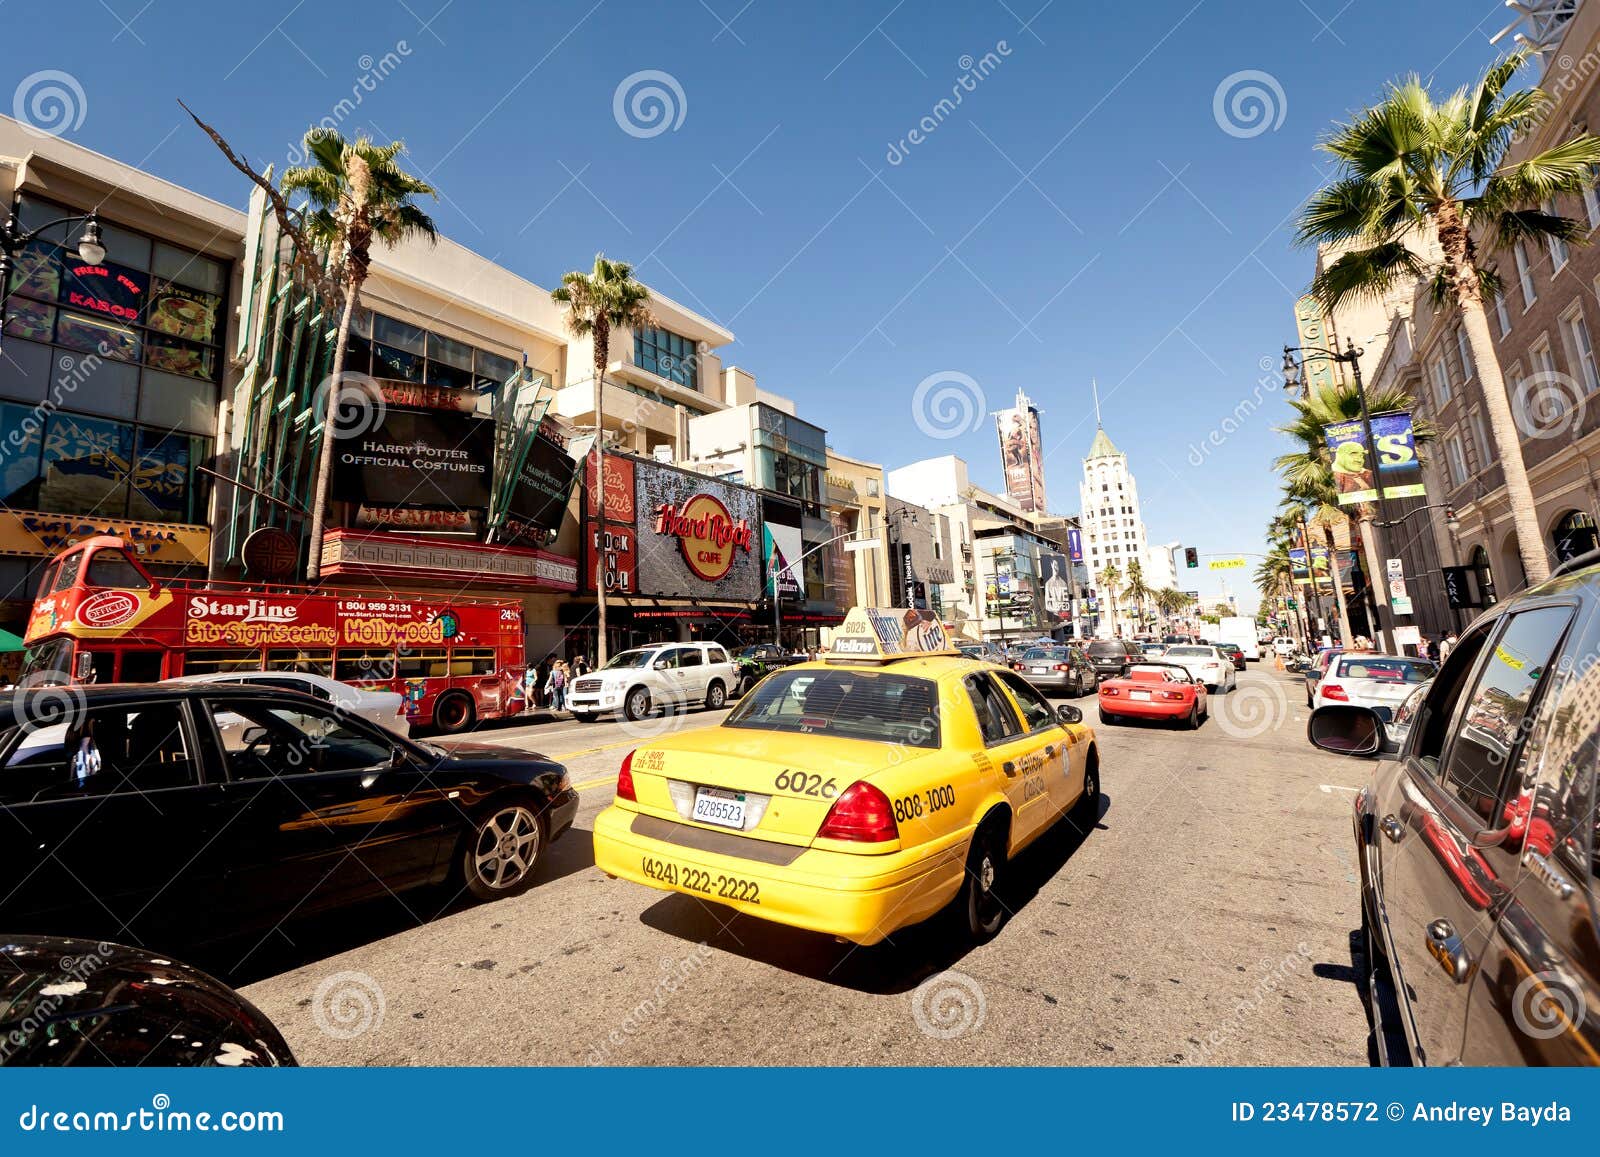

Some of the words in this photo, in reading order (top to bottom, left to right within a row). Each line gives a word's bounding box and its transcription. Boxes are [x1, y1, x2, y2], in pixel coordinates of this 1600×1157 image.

[52, 421, 121, 448] MAKE
[363, 441, 411, 455] HARRY
[416, 447, 468, 460] POTTER
[341, 453, 409, 468] OFFICIAL
[413, 458, 486, 473] COSTUMES
[107, 469, 184, 498] TDAY!
[654, 502, 710, 540] Hard
[709, 513, 753, 553] Rock
[698, 551, 722, 565] CAFE
[596, 562, 629, 590] OLL
[88, 599, 129, 619] OFFICIAL
[368, 602, 387, 611] 959
[389, 603, 411, 612] 3131
[905, 585, 914, 609] odak
[344, 618, 444, 646] Hollywood
[846, 621, 866, 634] 6026
[835, 639, 875, 653] Yellow
[775, 768, 838, 799] 6026
[697, 799, 742, 822] 8Z85523
[895, 784, 955, 823] 808-1000
[642, 856, 679, 886] (424)
[682, 867, 760, 904] 222-2222
